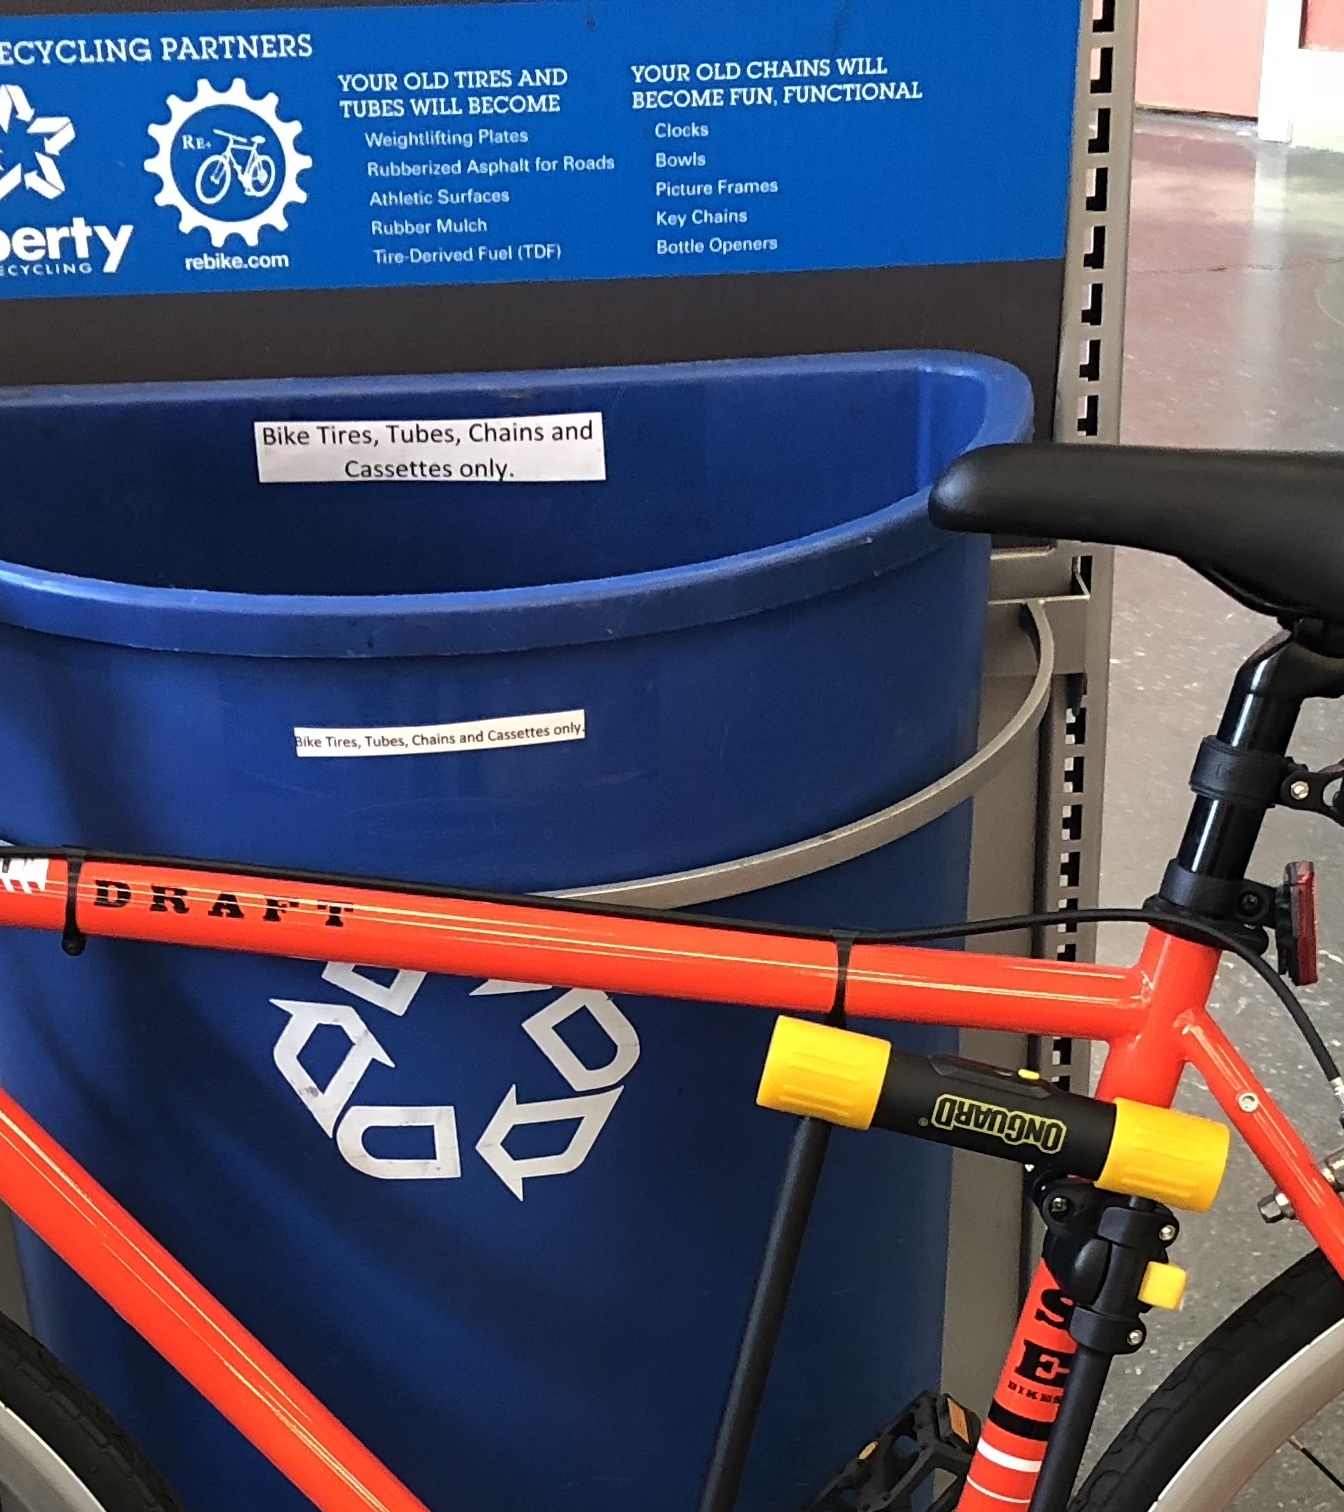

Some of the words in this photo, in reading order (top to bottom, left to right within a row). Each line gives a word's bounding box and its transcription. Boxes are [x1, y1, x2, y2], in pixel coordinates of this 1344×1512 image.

[160, 33, 313, 61] PARTNERS
[337, 72, 398, 92] YOUR
[403, 71, 450, 91] OLD
[453, 69, 513, 89] TIRES
[517, 67, 568, 87] AND
[630, 63, 691, 84] YOUR
[696, 62, 741, 82] OLD
[746, 58, 831, 80] CHAINS
[835, 56, 888, 76] WILL
[631, 89, 725, 109] BECOME
[729, 86, 778, 106] FUN,
[783, 81, 923, 104] FUNCTIONAL
[339, 98, 405, 119] TUBES
[409, 97, 463, 117] WILL
[467, 94, 561, 115] BECOME
[364, 129, 473, 150] Weightlifting
[478, 128, 529, 144] Plates
[654, 121, 710, 139] Clocks
[367, 159, 462, 177] Rubberized
[466, 157, 530, 177] Asphalt
[534, 156, 559, 172] for
[563, 154, 615, 171] Roads
[655, 151, 706, 168] Bowls
[369, 190, 433, 207] Athletic
[437, 188, 510, 205] Surfaces
[655, 181, 713, 197] Picture
[717, 179, 779, 195] Frames
[371, 219, 432, 236] Rubber
[436, 217, 488, 234] Mulch
[656, 210, 687, 228] Key
[691, 209, 748, 225] Chains
[372, 247, 474, 264] Tire-Derived
[478, 245, 513, 261] Fuel
[517, 243, 562, 260] (TDF)
[656, 238, 705, 255] Bottle
[708, 237, 778, 255] Openers
[184, 252, 290, 271] rebike.com
[262, 425, 310, 446] Bike
[316, 425, 379, 448] Tires,
[385, 423, 461, 447] Tubes,
[468, 420, 545, 443] Chains
[551, 419, 593, 442] and
[344, 459, 453, 478] Cassettes
[459, 457, 514, 481] only.
[296, 735, 322, 748] Bike
[324, 735, 362, 750] Tires,
[364, 735, 409, 749] Tubes,
[411, 733, 456, 747] Chains
[459, 730, 484, 744] and
[487, 726, 550, 742] Cassettes
[553, 721, 585, 738] only.
[93, 879, 354, 928] DRAFT
